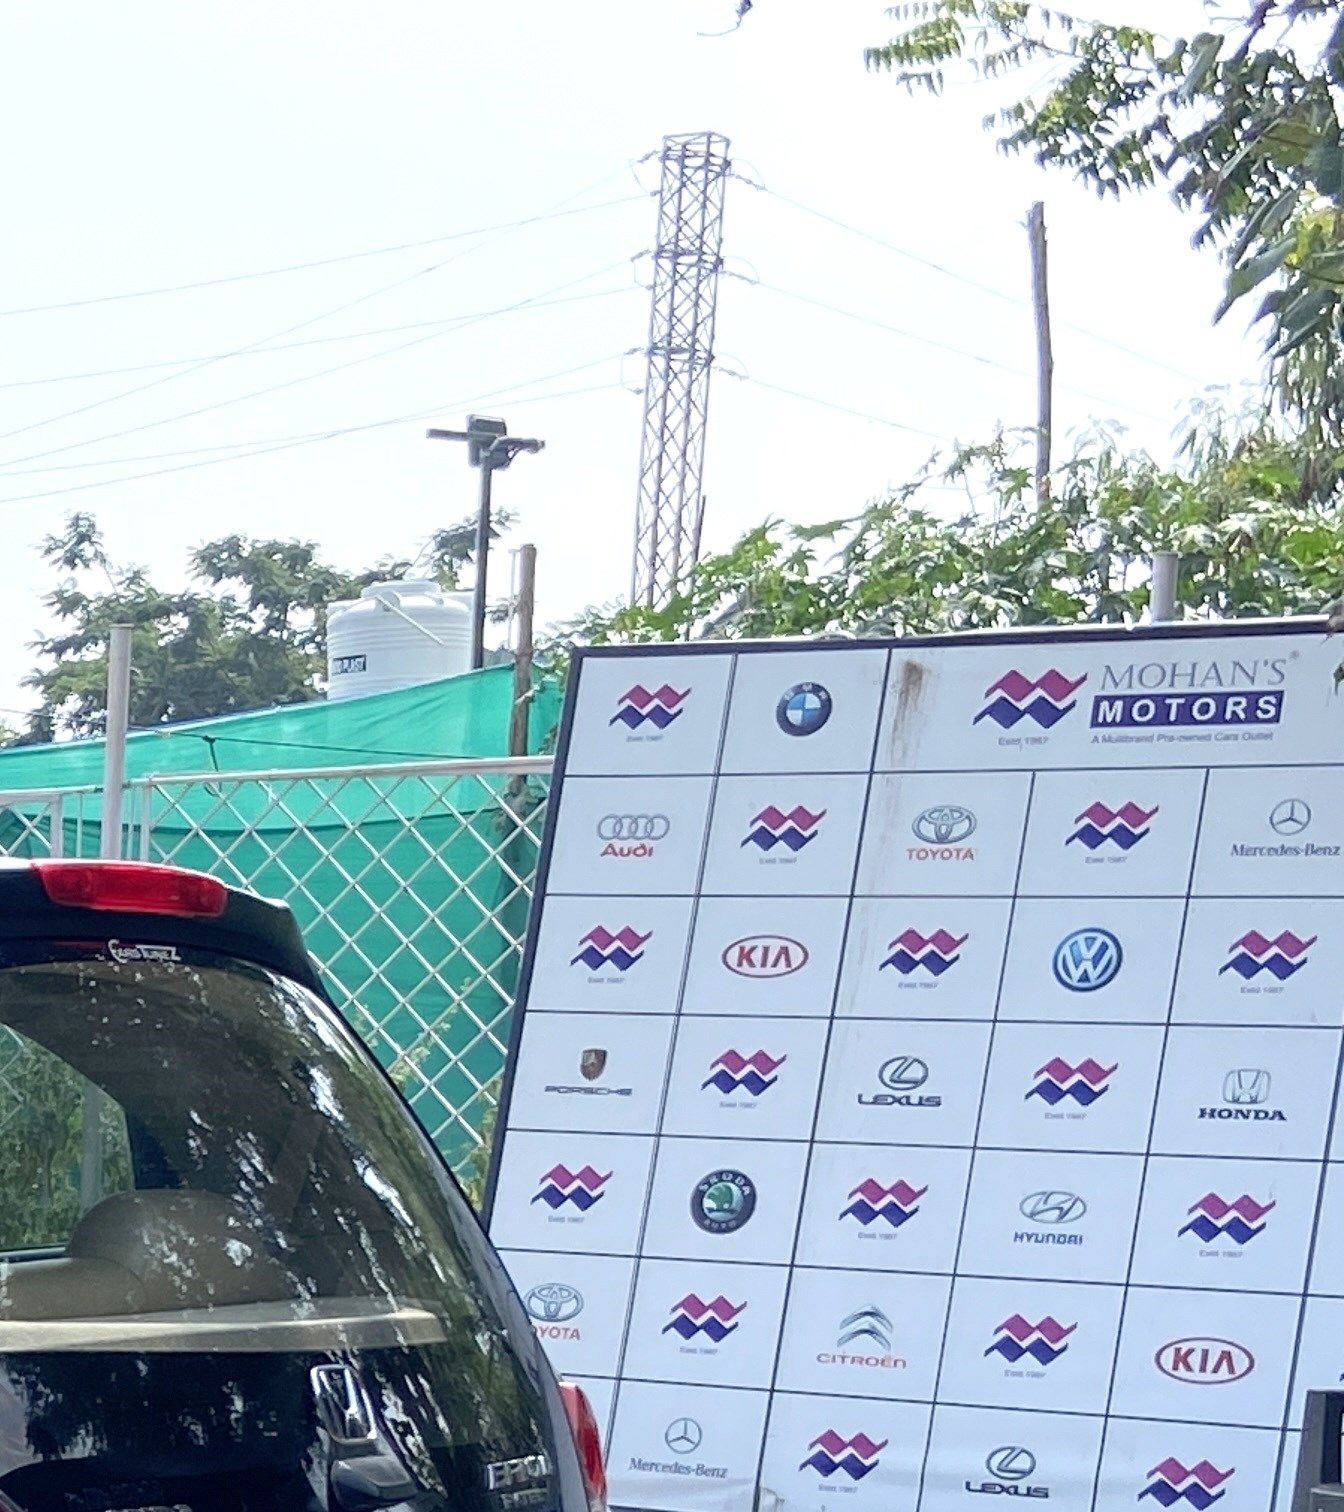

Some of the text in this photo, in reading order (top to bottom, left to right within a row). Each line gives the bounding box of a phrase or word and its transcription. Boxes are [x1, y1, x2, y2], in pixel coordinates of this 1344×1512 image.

[1101, 658, 1287, 691] MOHAN'S
[1097, 695, 1278, 723] MOTORS
[600, 842, 655, 858] Audi
[906, 848, 975, 861] TOYOTA
[1230, 843, 1341, 858] Mercedes-Benz
[736, 945, 793, 969] KIA
[544, 1085, 633, 1096] PORSCHE
[857, 1093, 943, 1107] LEXUS
[1197, 1107, 1287, 1121] HONDA
[1013, 1231, 1084, 1245] HYUNDAI
[533, 1325, 581, 1341] YOTA
[1171, 1346, 1238, 1375] KIA
[628, 1457, 728, 1479] Mercedes-Benz
[965, 1481, 1050, 1499] LEXUS
